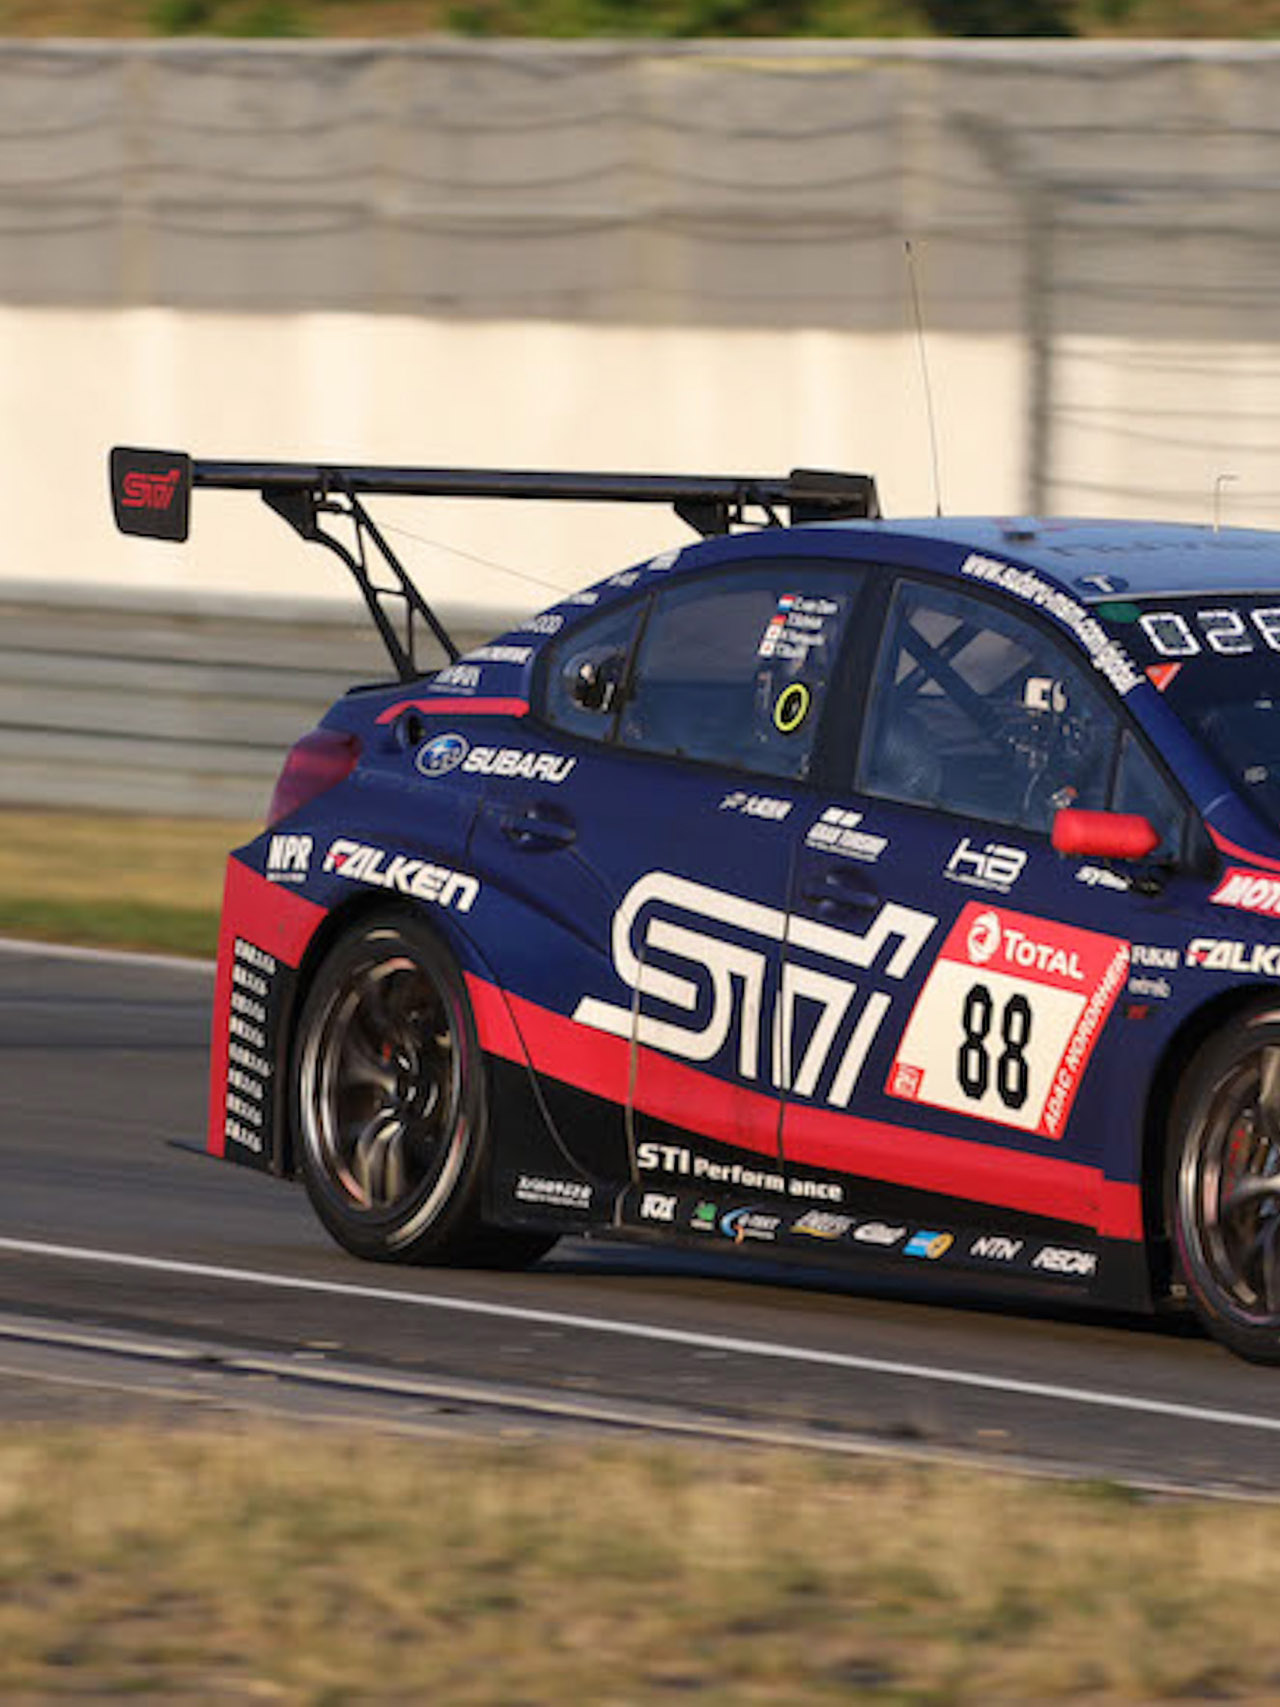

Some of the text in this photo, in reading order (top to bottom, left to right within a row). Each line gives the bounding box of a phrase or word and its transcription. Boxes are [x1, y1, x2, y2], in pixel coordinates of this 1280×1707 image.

[461, 746, 577, 784] SUBARU
[268, 834, 314, 872] NPR
[322, 837, 481, 913] FALKEN
[1002, 928, 1086, 981] TOTAL
[570, 870, 939, 1109] STI
[956, 982, 1032, 1110] 88
[636, 1143, 844, 1202] STI Performance
